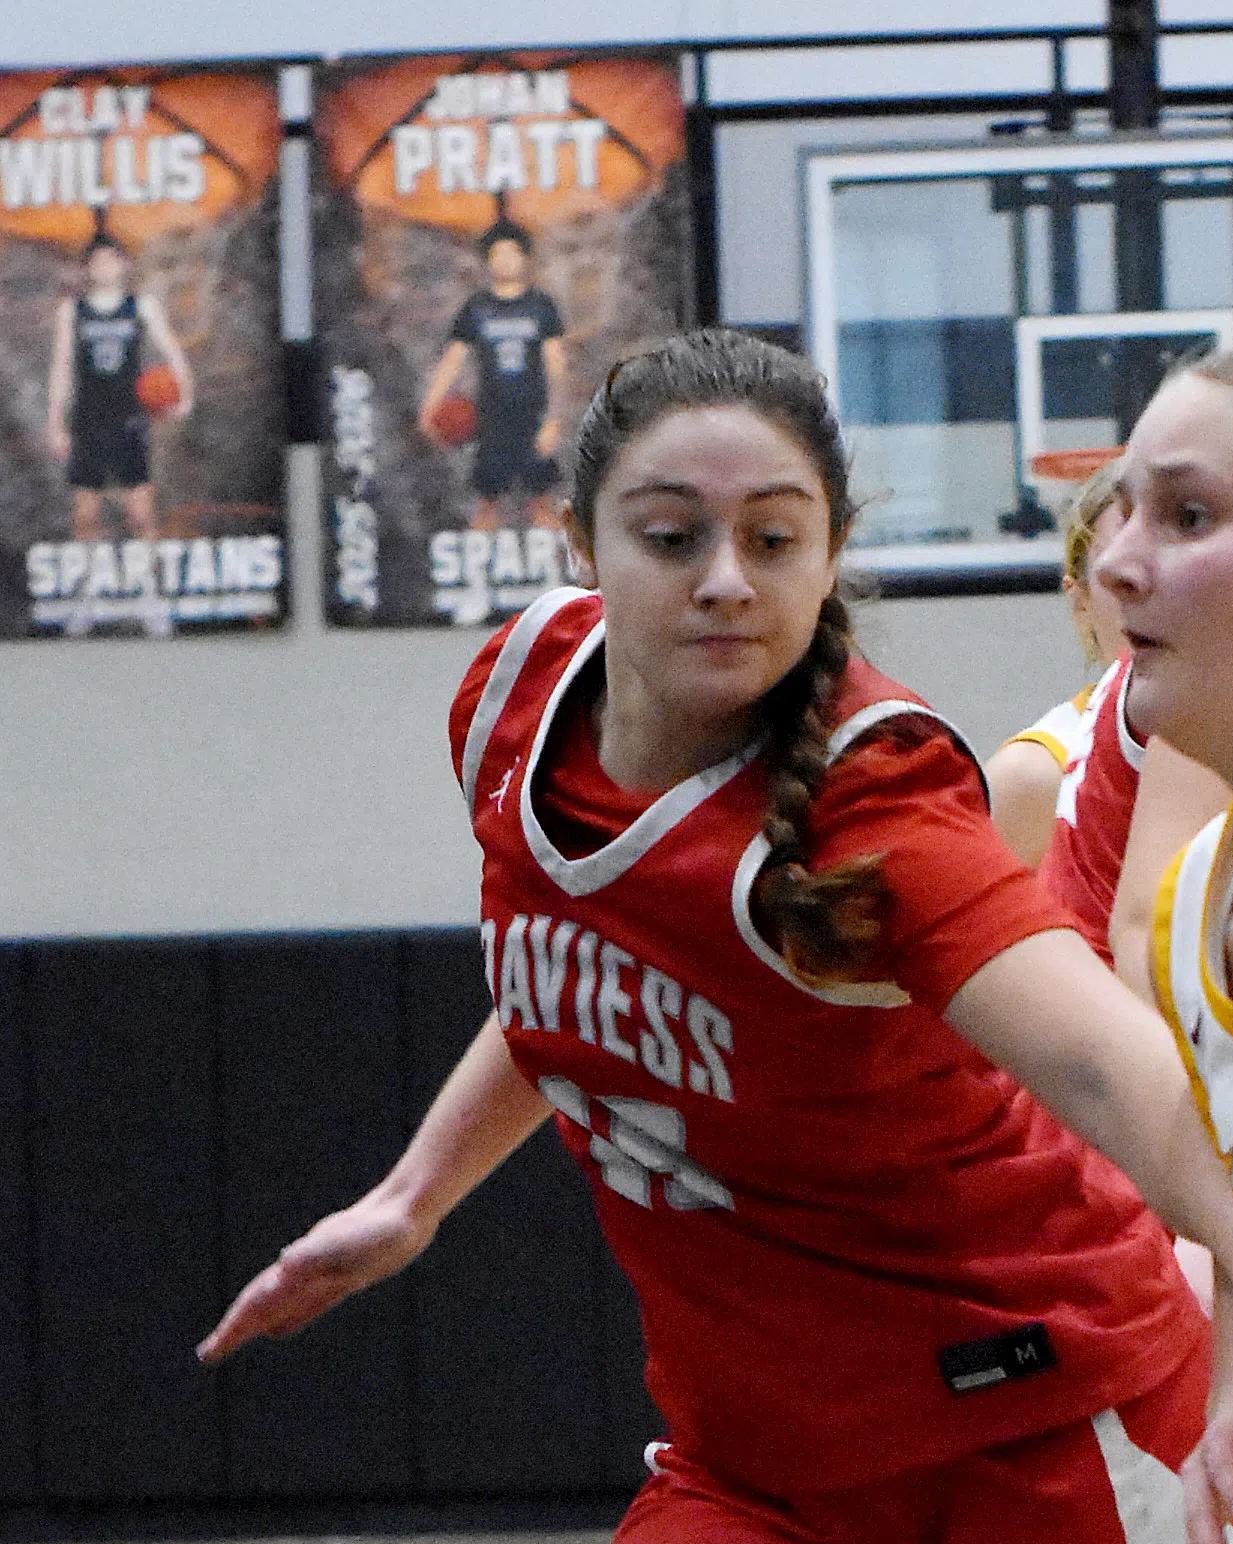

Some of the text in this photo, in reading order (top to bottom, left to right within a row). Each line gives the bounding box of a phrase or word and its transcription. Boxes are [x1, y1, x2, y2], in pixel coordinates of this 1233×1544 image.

[40, 84, 152, 134] CLAY
[0, 132, 205, 210] WILLIS
[395, 118, 609, 196] PRATT
[27, 535, 282, 598] SPARTANS
[481, 913, 736, 1104] AVIESS
